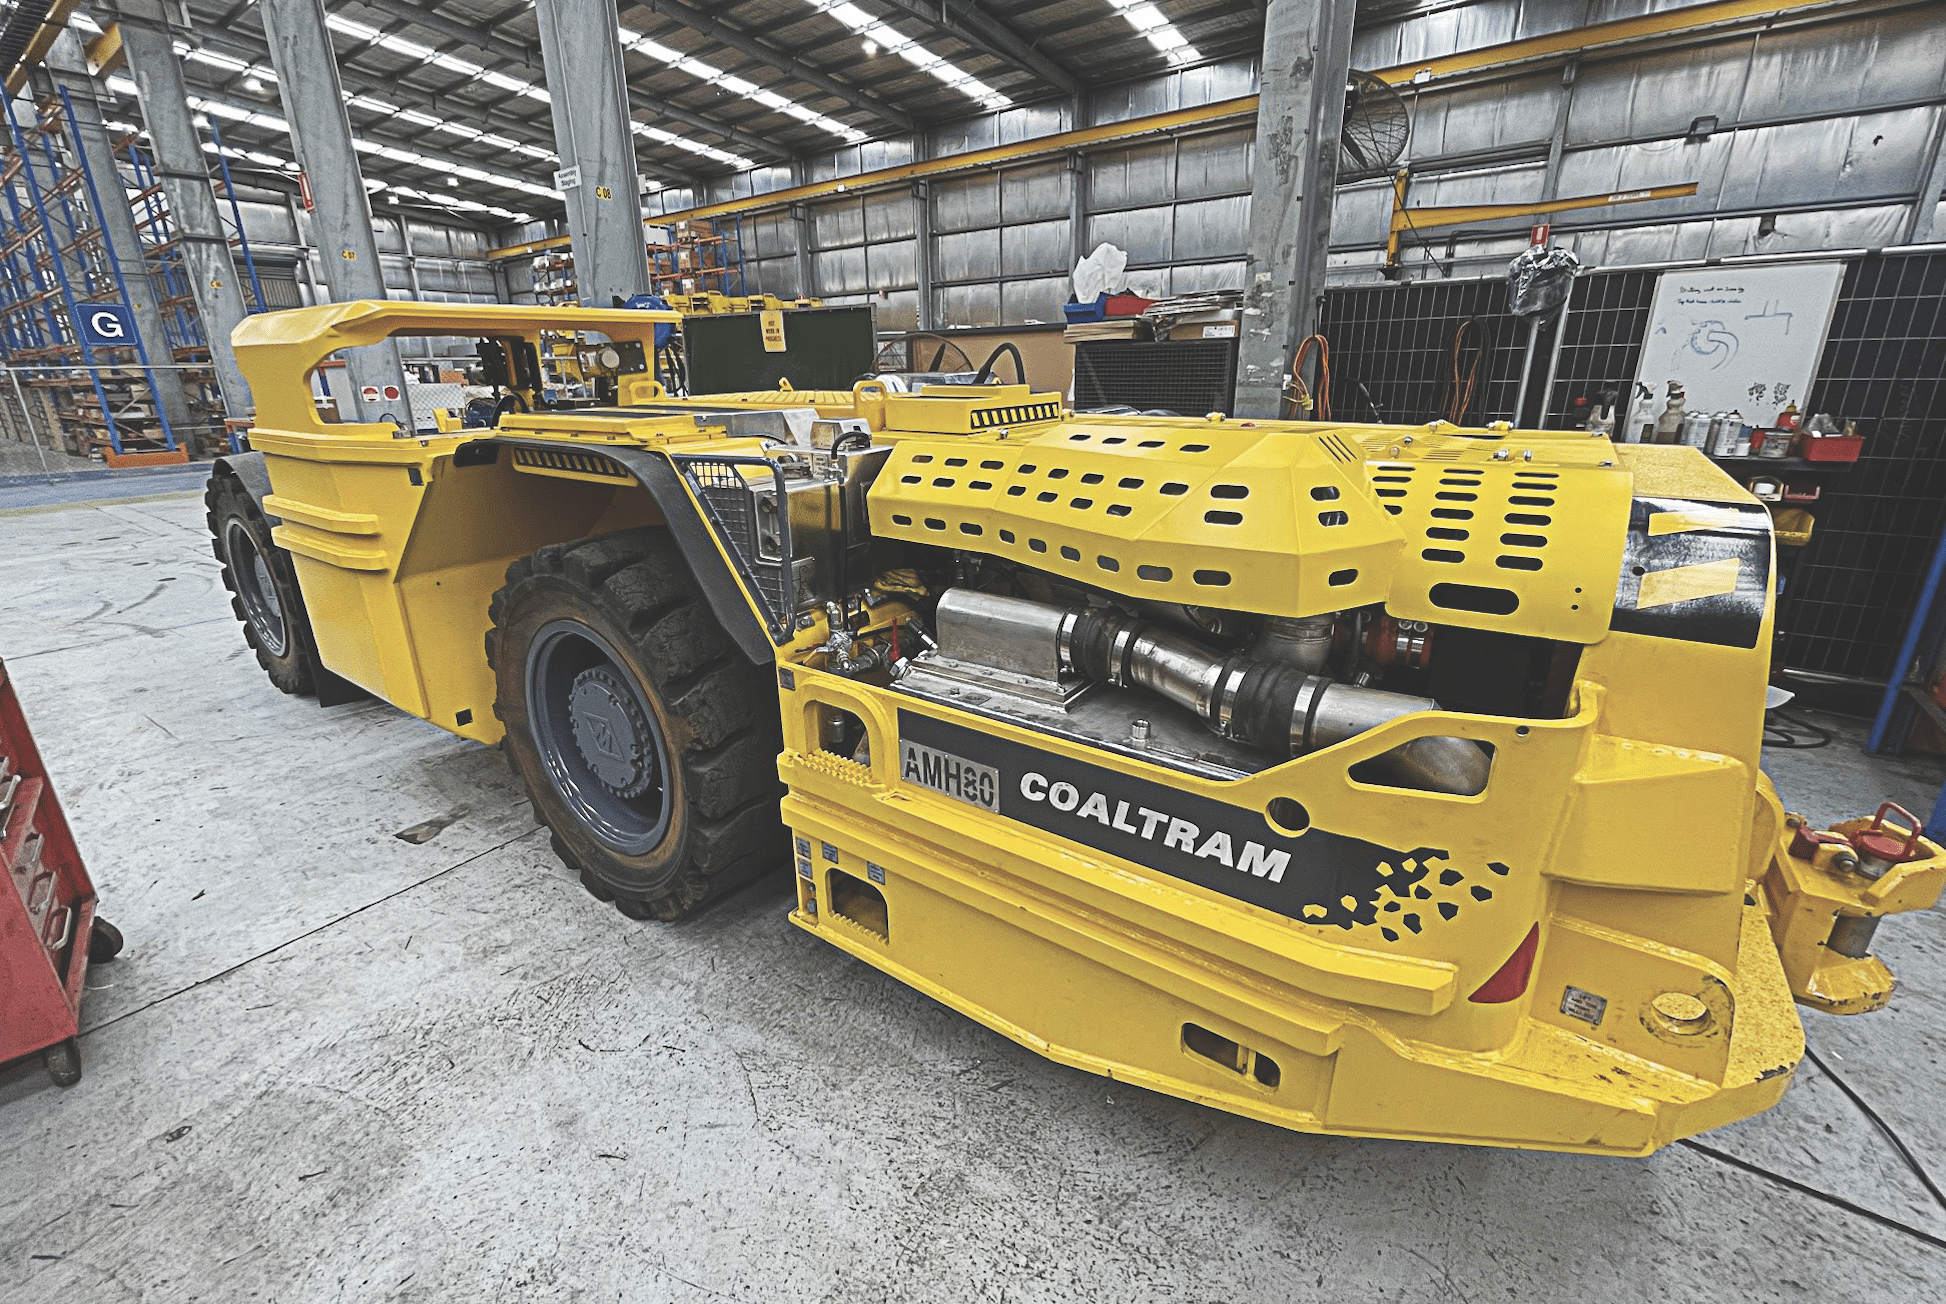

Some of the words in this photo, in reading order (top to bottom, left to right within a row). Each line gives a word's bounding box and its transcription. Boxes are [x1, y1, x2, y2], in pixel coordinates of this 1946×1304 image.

[558, 169, 577, 179] Assembly
[561, 178, 576, 187] Staging
[91, 311, 124, 338] G
[904, 746, 995, 808] AMH80
[1019, 771, 1293, 884] COALTRAM
